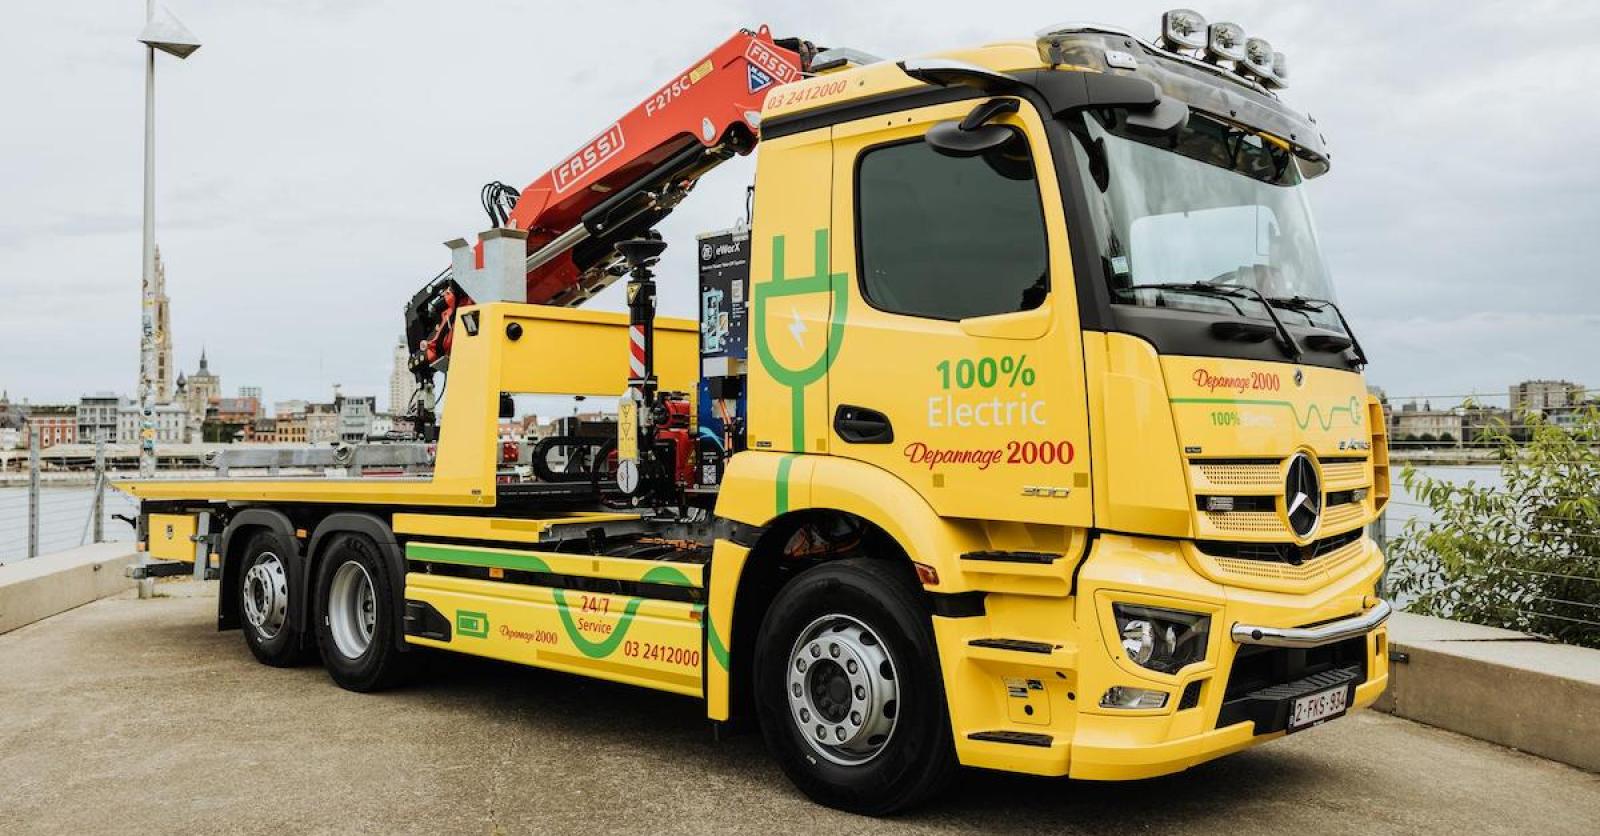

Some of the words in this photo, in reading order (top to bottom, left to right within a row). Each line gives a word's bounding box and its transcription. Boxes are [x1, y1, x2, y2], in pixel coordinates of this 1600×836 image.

[750, 45, 792, 81] FASSI
[645, 75, 692, 117] F275C
[767, 93, 784, 110] 03
[786, 79, 847, 107] 2412000
[557, 132, 619, 185] FASSI
[936, 354, 1036, 390] 100%
[1192, 368, 1250, 394] Depannage
[1251, 371, 1280, 392] 2000
[928, 392, 1046, 427] Electric
[1211, 411, 1241, 426] 100%
[903, 441, 1003, 470] Depannage
[1006, 440, 1075, 465] 2000
[581, 595, 610, 615] 24/7
[535, 630, 558, 645] 2000
[577, 617, 612, 635] Service
[623, 640, 639, 658] 03
[643, 642, 700, 668] 2412000
